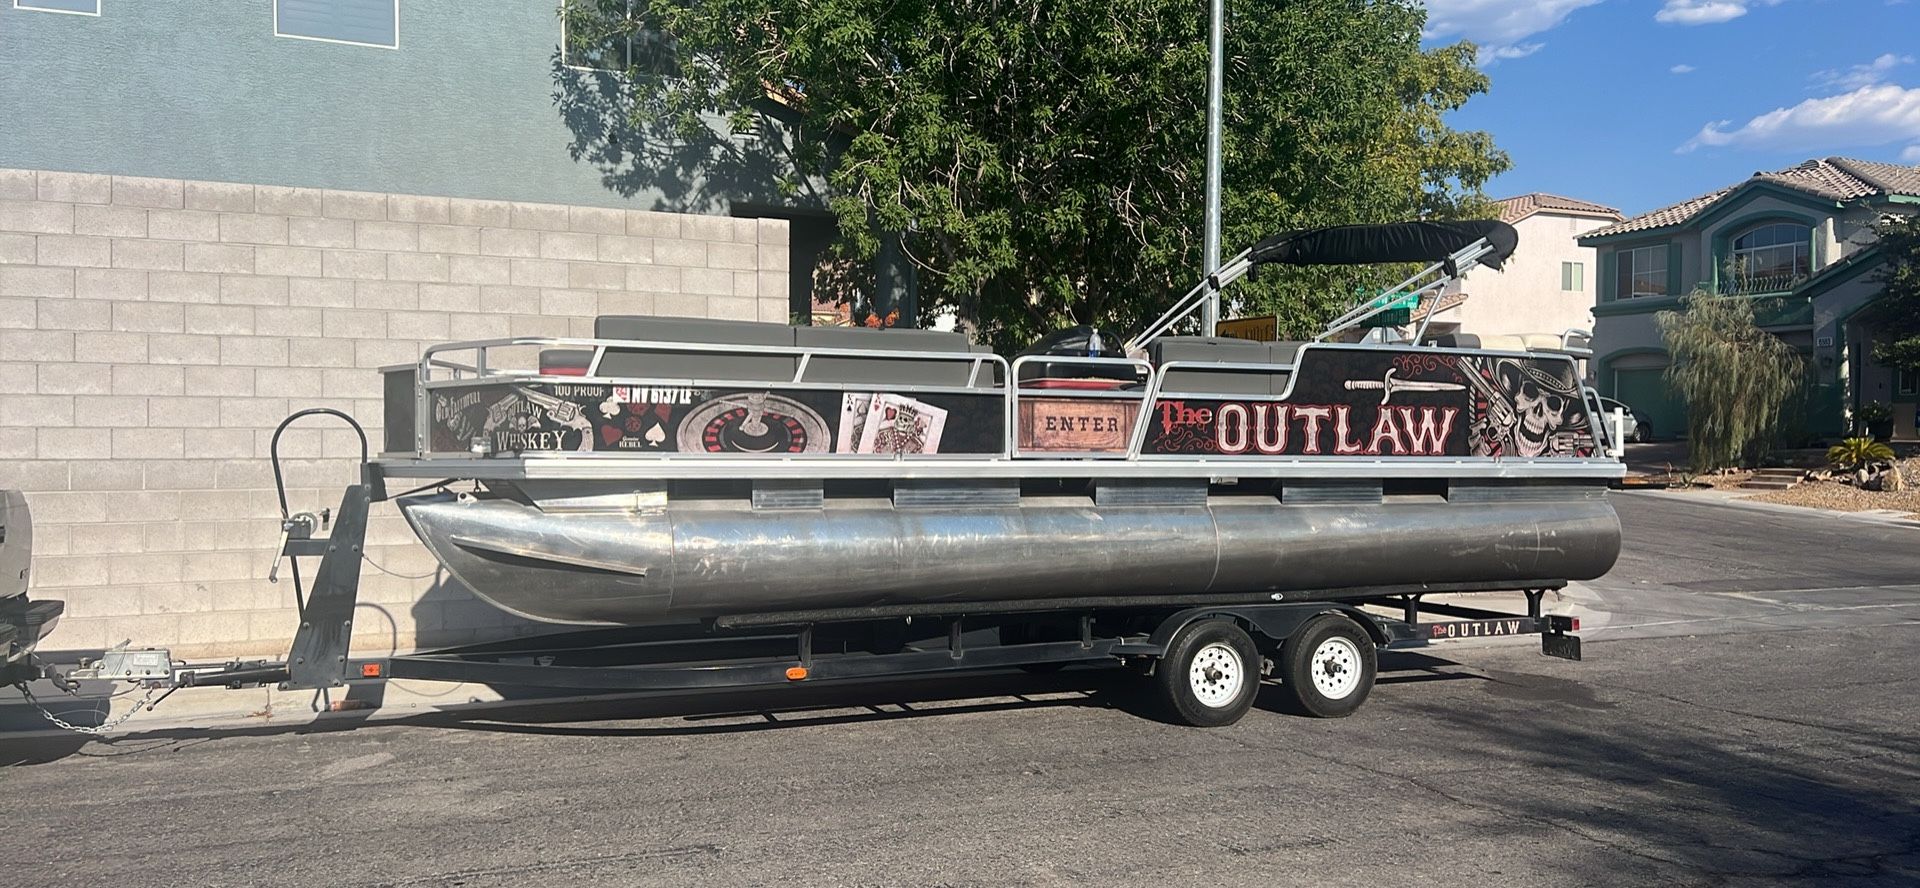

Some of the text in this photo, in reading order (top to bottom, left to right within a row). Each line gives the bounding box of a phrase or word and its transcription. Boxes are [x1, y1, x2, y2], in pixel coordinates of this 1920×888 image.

[554, 385, 604, 397] 100 PROOF
[1045, 416, 1119, 432] ENTER
[1155, 401, 1459, 455] The OUTLAW
[496, 430, 567, 451] WHISKEY
[1432, 621, 1520, 638] The OUTLAW
